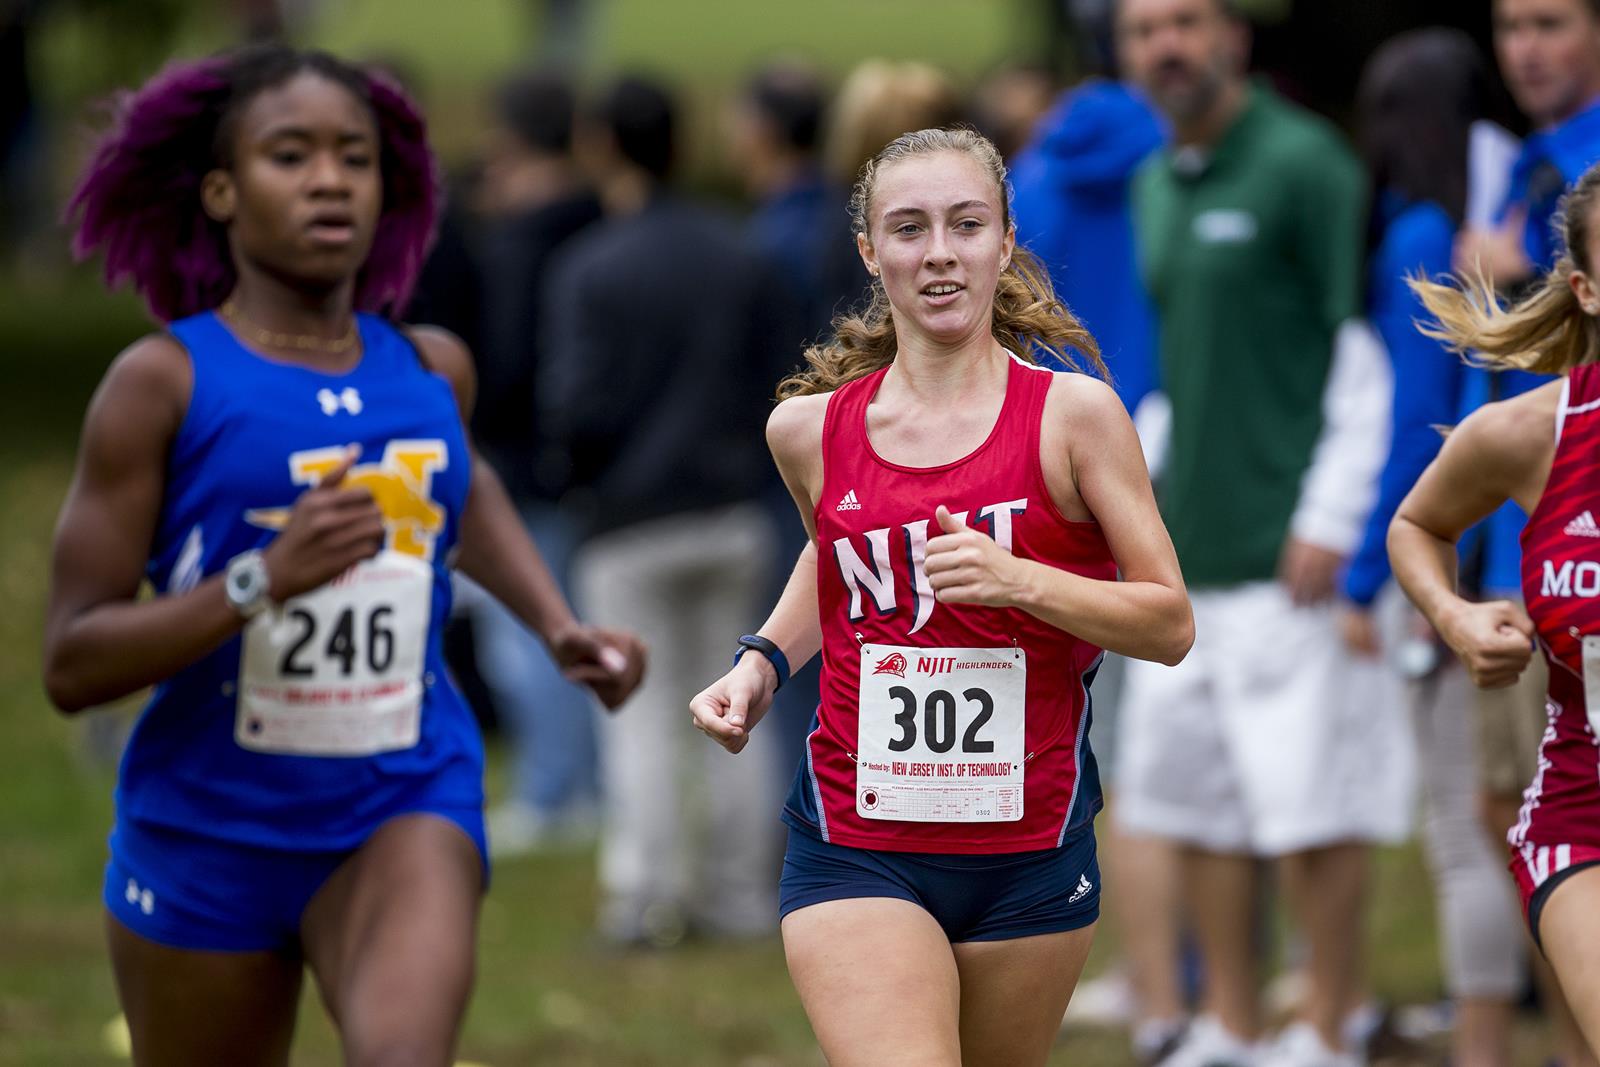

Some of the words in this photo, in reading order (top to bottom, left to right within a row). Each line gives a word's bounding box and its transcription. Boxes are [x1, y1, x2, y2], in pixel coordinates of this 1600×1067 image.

[836, 502, 861, 511] adidas
[833, 498, 1028, 635] NJT
[1540, 559, 1600, 597] MO
[278, 605, 396, 680] 246
[916, 656, 956, 677] NJIT
[956, 662, 1012, 670] HIGHLANDERS
[888, 685, 994, 753] 302
[868, 762, 883, 771] Hosted
[892, 762, 907, 775] NEW
[908, 762, 935, 776] JERSEY
[937, 763, 954, 777] INST.
[956, 763, 965, 777] OF
[967, 762, 1011, 777] TECHNOLOGY
